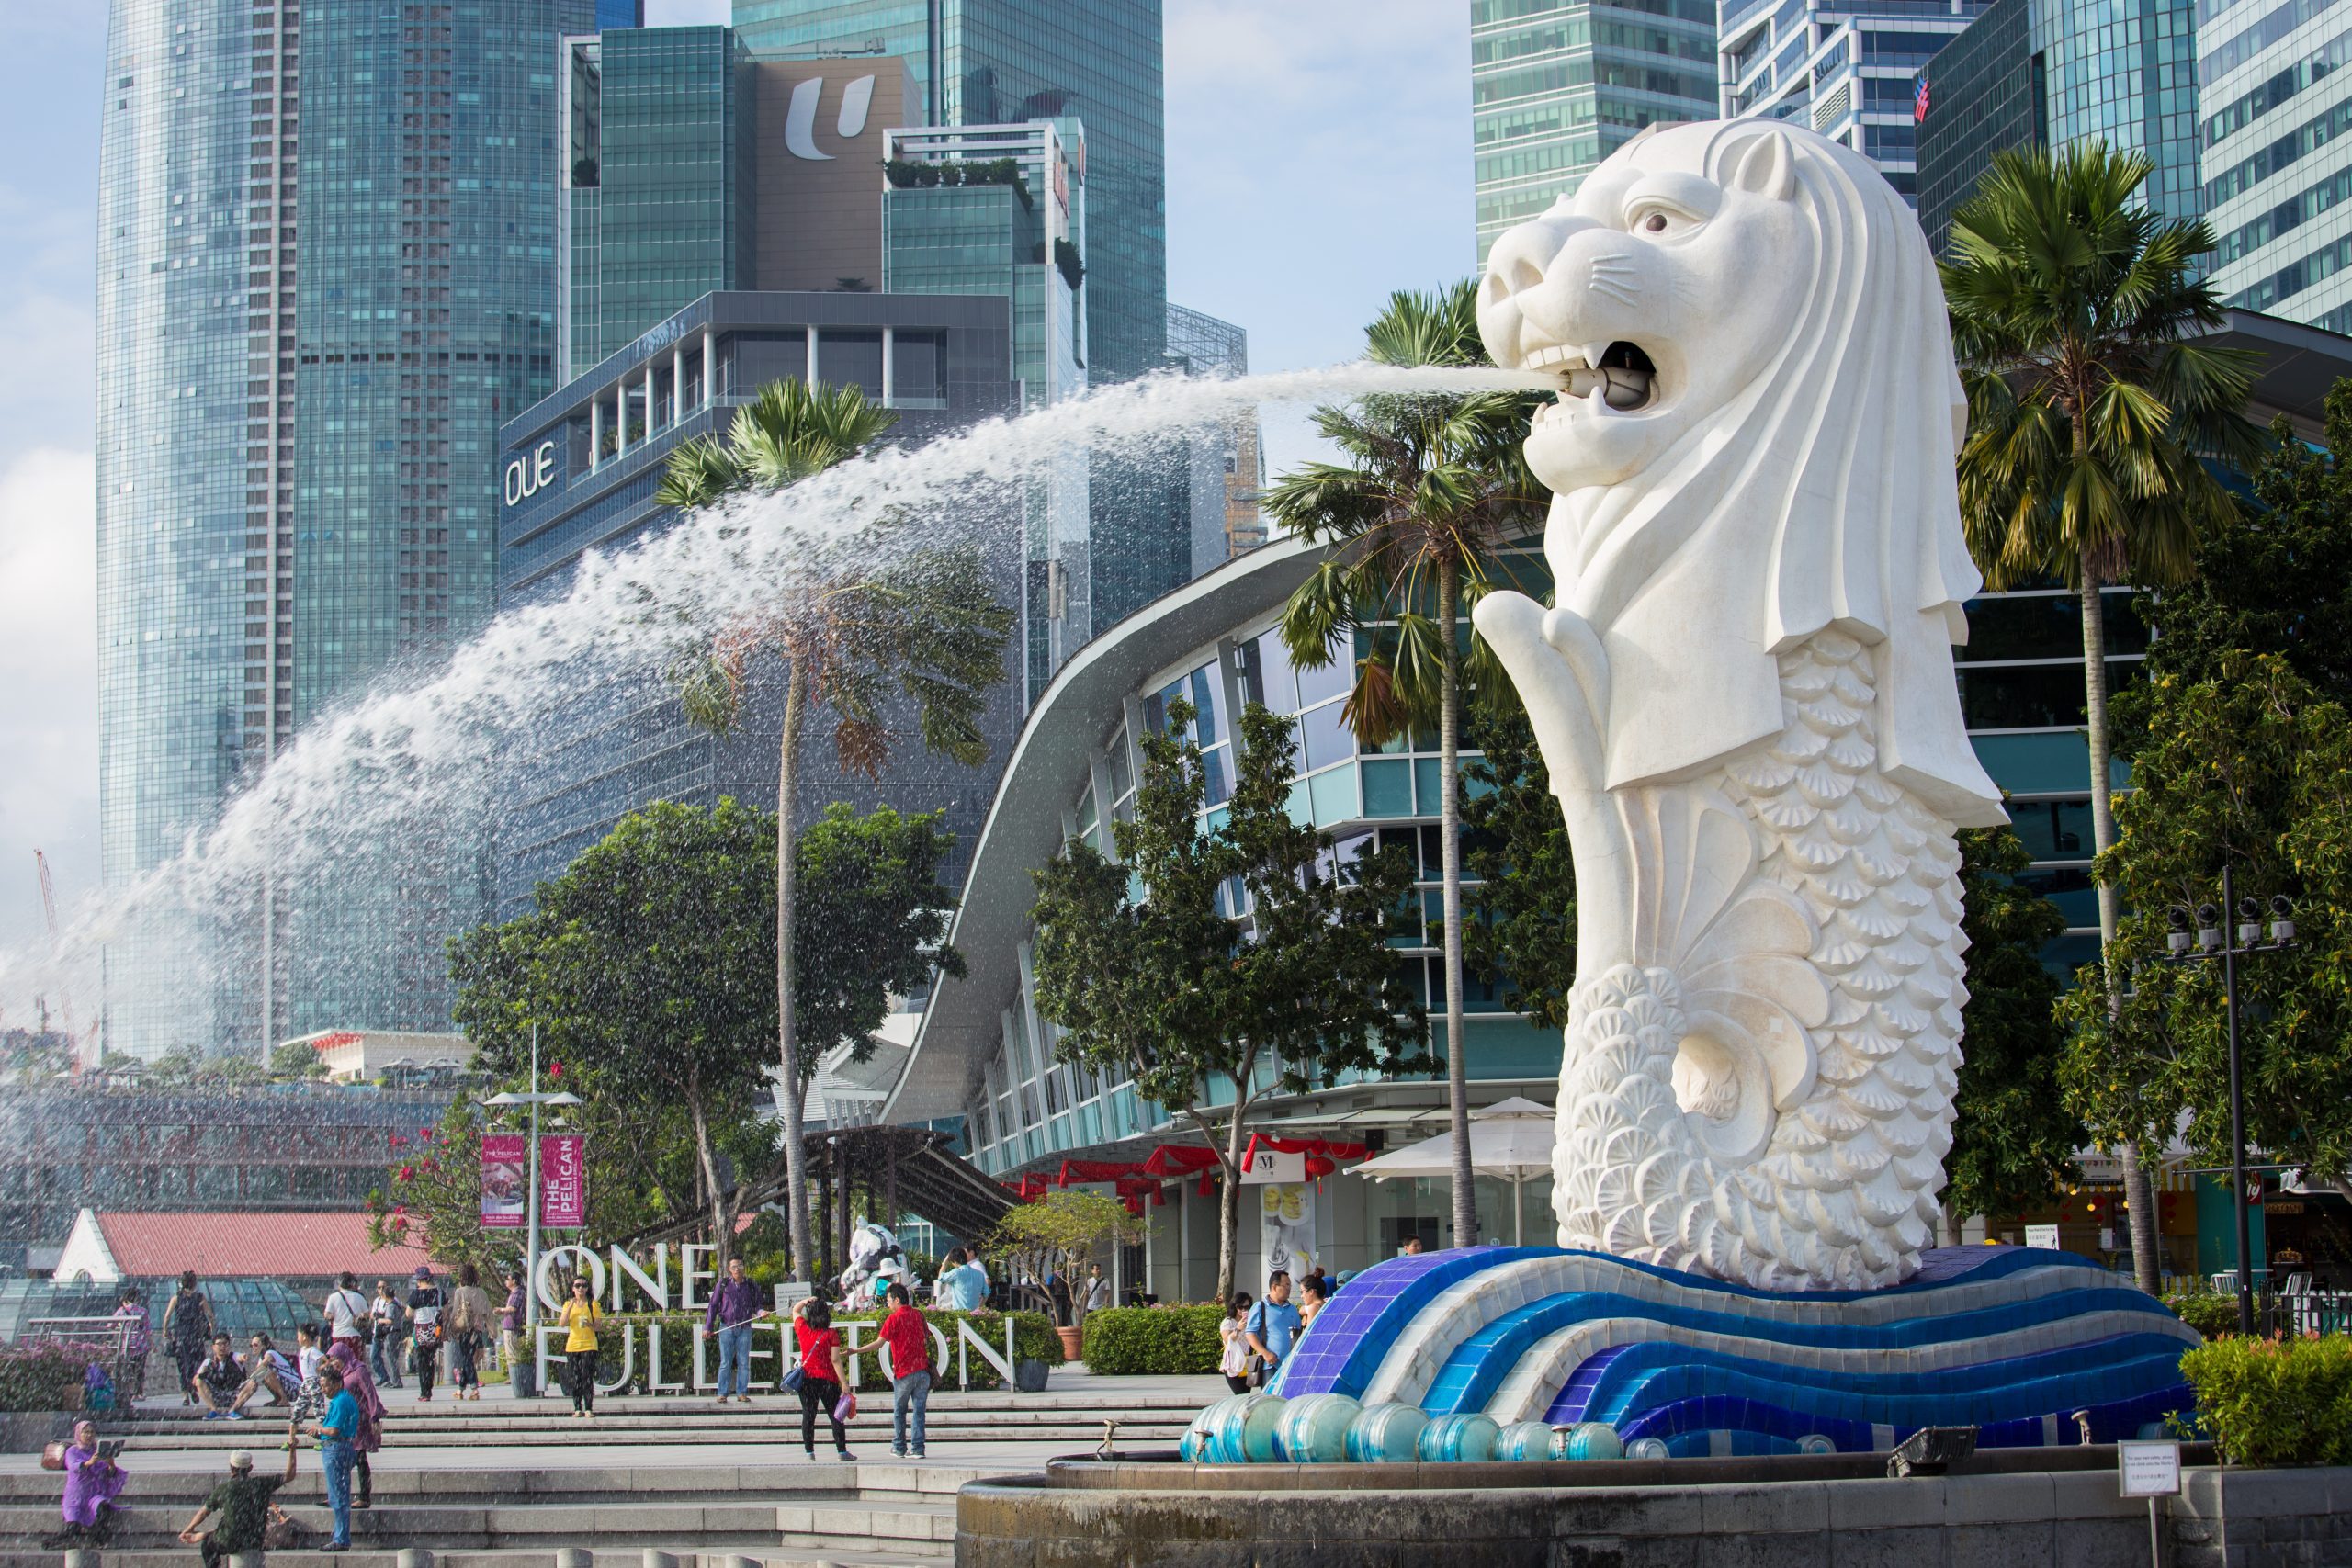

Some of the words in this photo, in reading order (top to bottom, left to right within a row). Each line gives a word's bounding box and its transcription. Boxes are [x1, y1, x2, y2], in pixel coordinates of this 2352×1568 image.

[505, 440, 555, 507] OUE
[547, 1179, 560, 1213] THE
[560, 1140, 573, 1213] PELICAN
[535, 1243, 718, 1313] ONE
